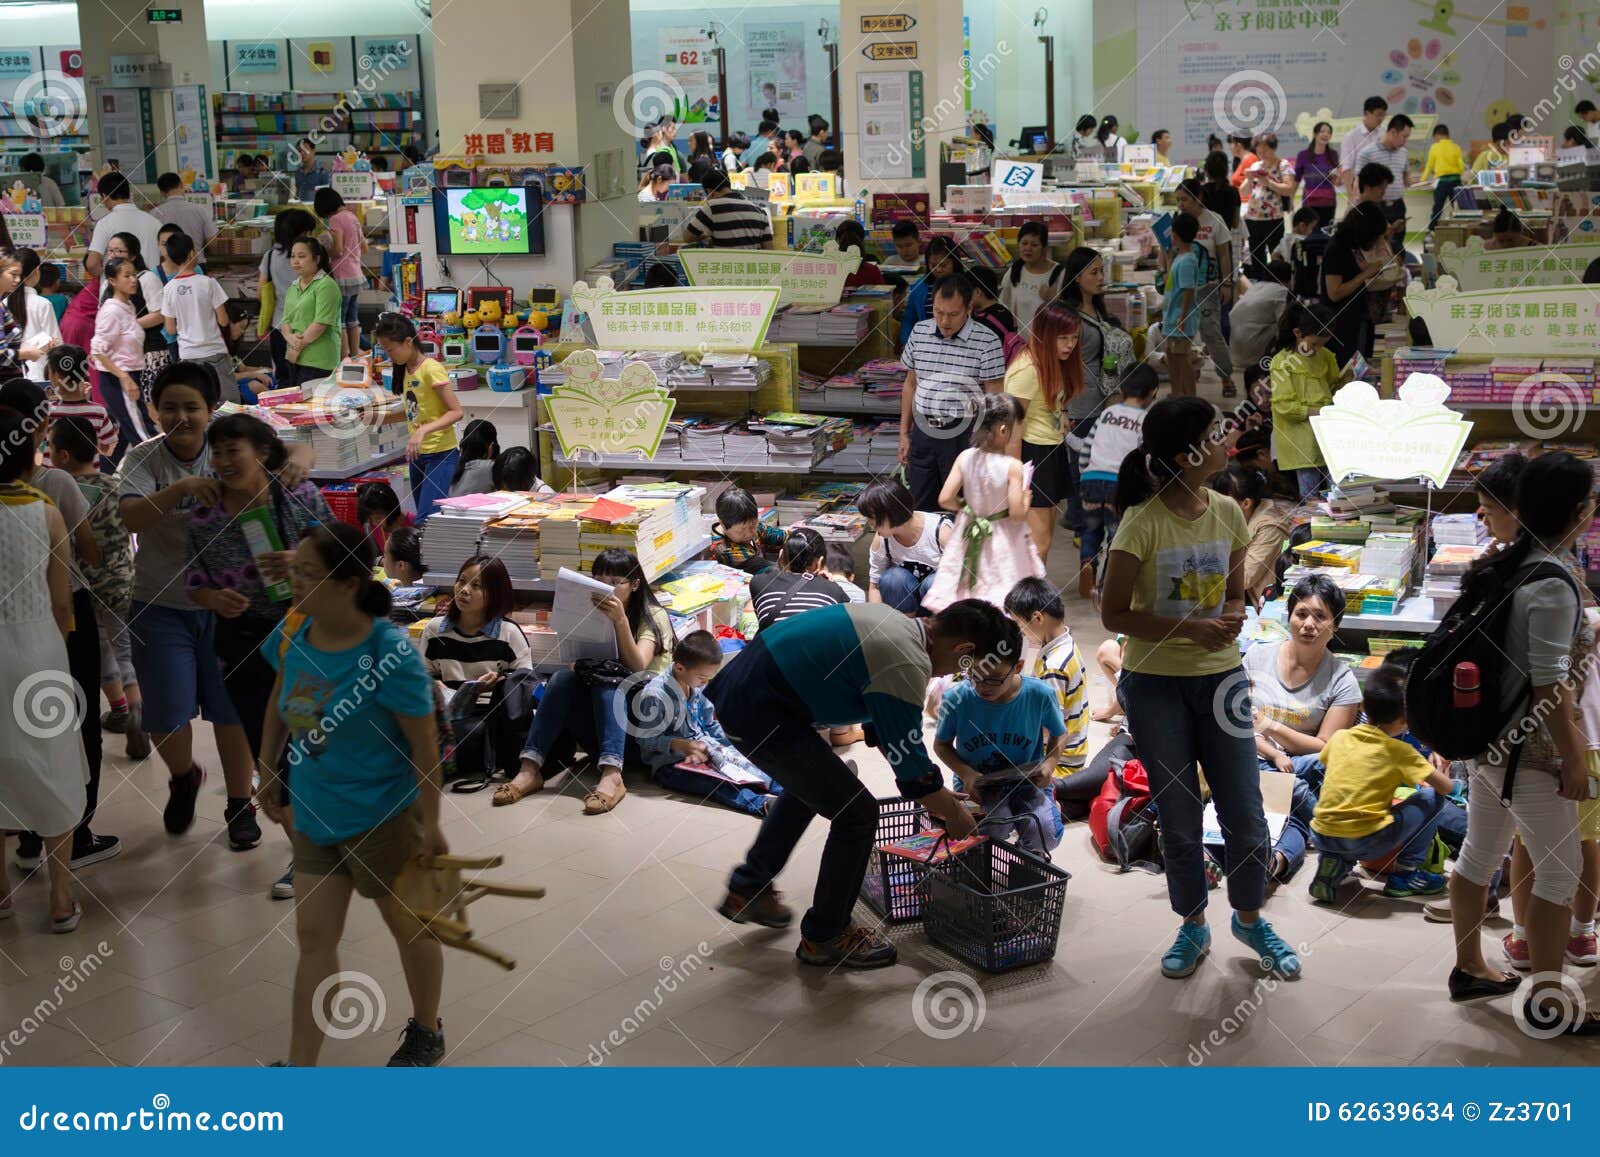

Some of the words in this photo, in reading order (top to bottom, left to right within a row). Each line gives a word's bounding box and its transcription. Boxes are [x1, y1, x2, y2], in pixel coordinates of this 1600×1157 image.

[1215, 9, 1340, 32] 亲子阅读中心
[239, 49, 276, 60] 文学读物
[680, 51, 698, 65] 62
